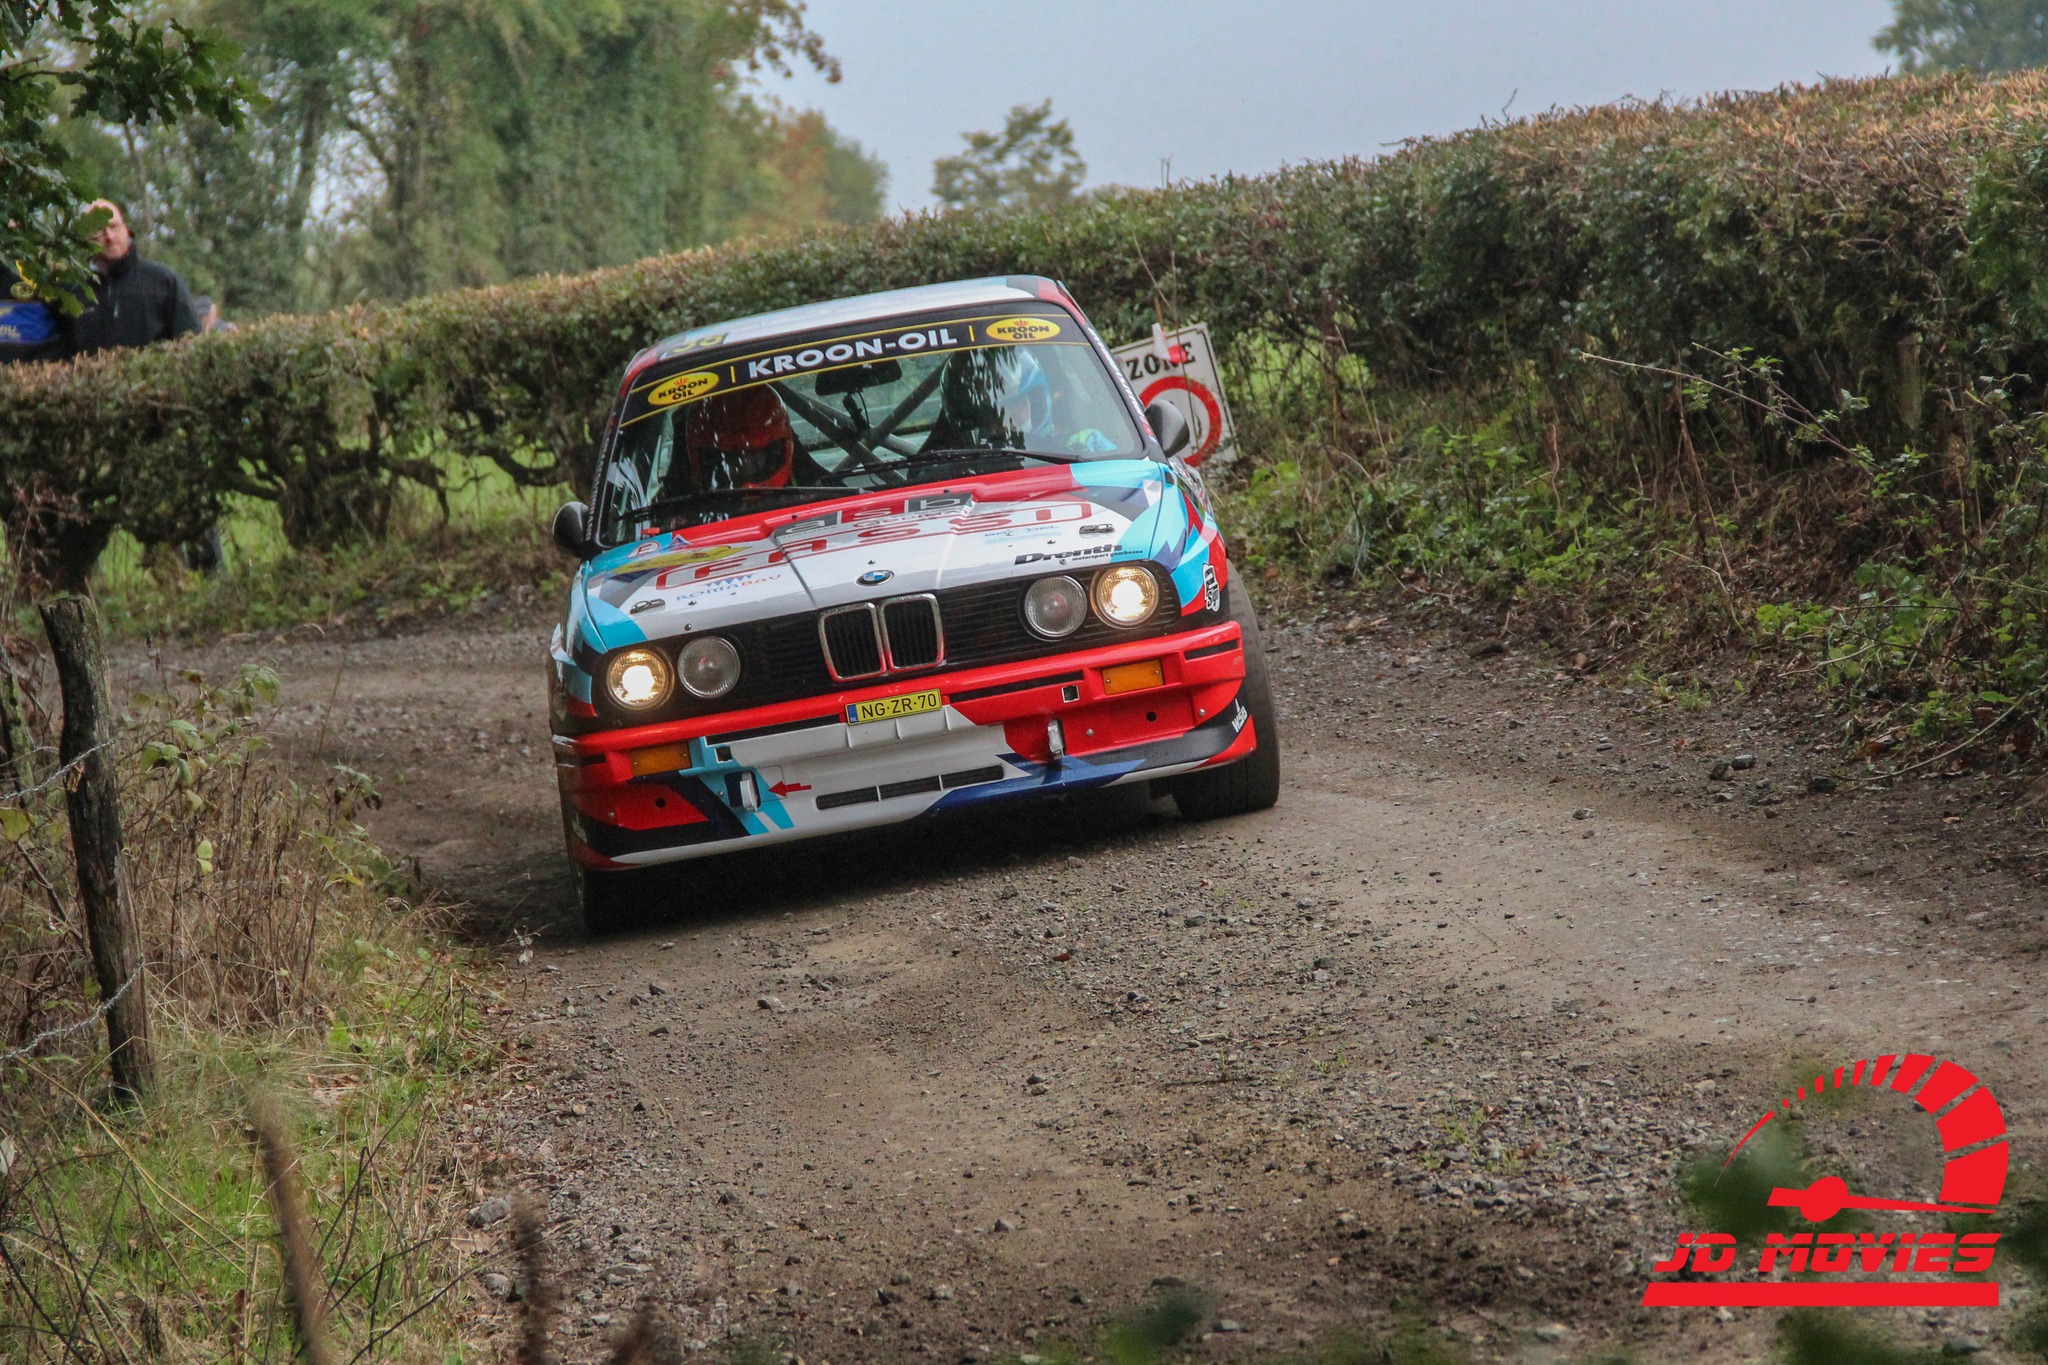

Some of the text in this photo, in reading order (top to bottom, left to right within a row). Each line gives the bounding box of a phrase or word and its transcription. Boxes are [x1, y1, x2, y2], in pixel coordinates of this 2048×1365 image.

[997, 325, 1050, 334] KROON
[1012, 332, 1036, 340] OIL
[748, 328, 958, 379] KROON-OIL
[657, 377, 709, 400] KROON
[671, 389, 695, 401] OIL
[1014, 544, 1123, 566] Drenth
[1071, 552, 1109, 561] motorsport
